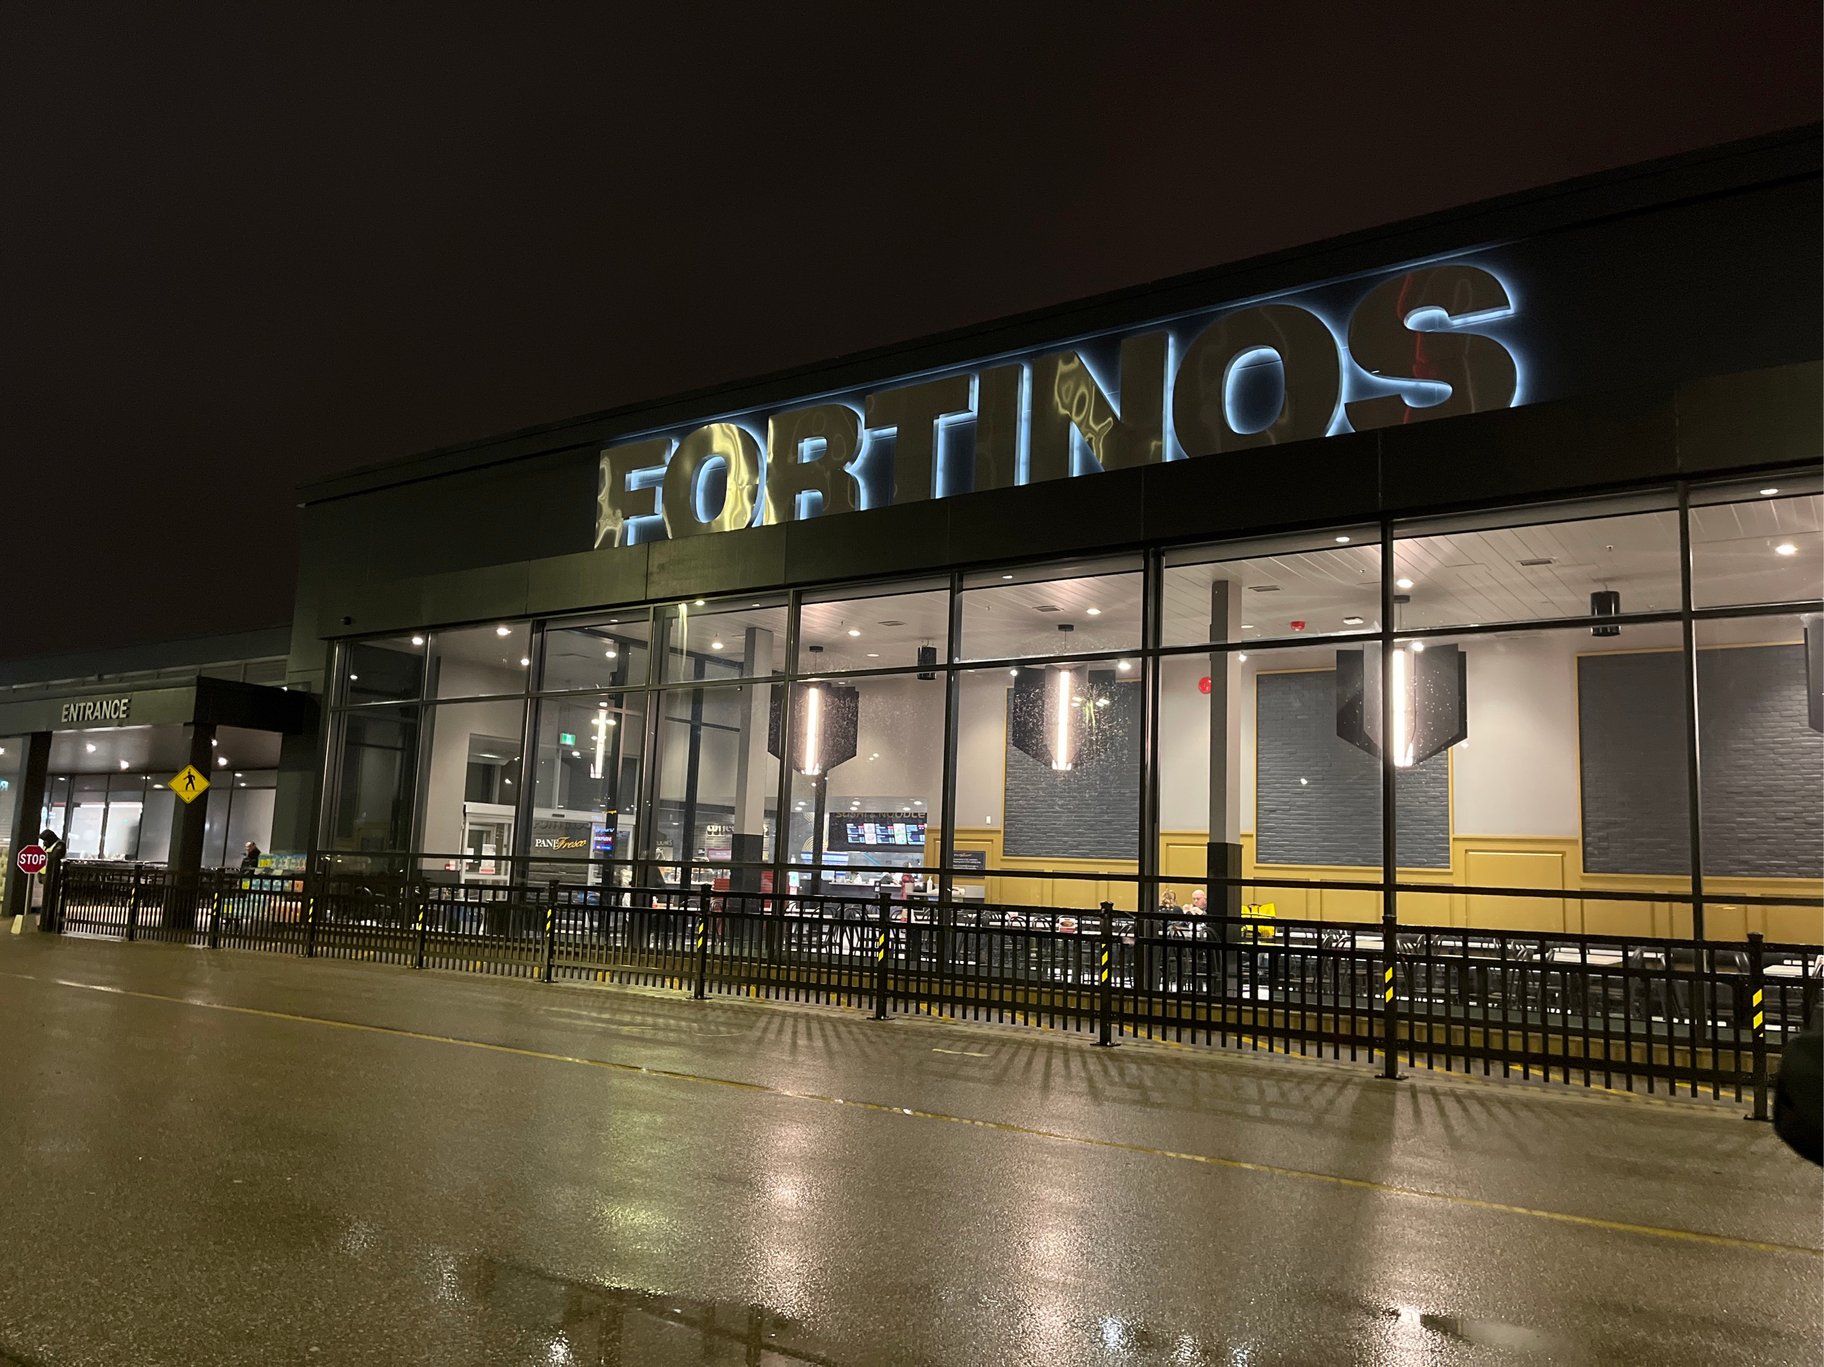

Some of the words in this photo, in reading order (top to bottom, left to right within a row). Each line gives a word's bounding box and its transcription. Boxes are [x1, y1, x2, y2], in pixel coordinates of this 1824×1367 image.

[595, 263, 1519, 550] FORTINOS
[61, 699, 129, 722] ENTRANCE
[535, 838, 559, 848] PANE
[553, 836, 587, 850] Fresco
[19, 853, 46, 865] STOP
